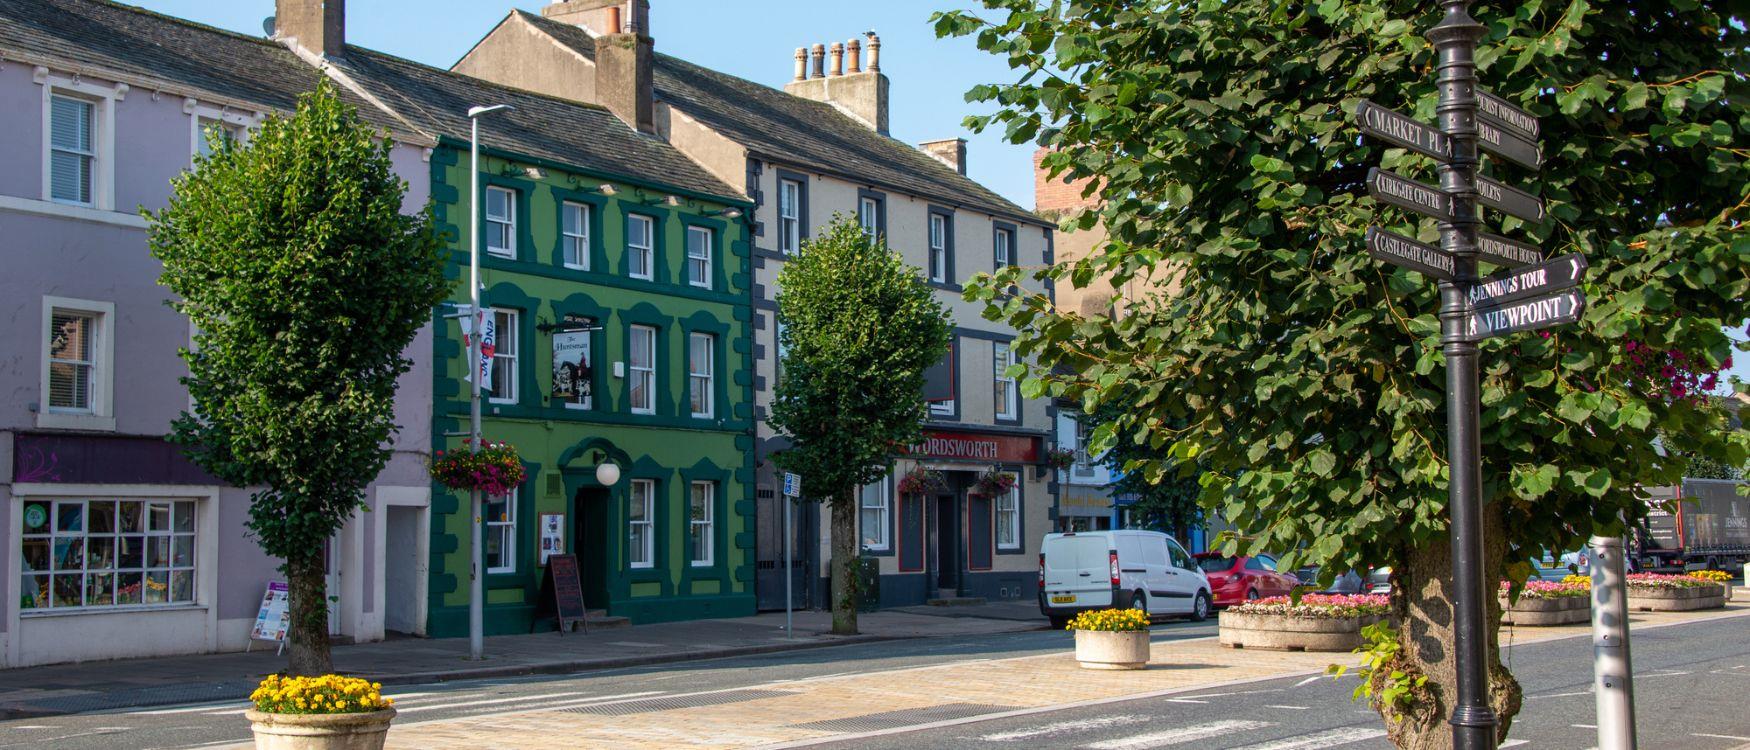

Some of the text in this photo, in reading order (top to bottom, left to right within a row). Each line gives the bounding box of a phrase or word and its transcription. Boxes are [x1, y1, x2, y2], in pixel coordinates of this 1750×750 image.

[1374, 109, 1442, 153] MARKET PL
[1499, 104, 1534, 133] INFORMATION
[1381, 176, 1440, 210] KIRKGATE CENTRE
[1380, 235, 1450, 272] CASTLEGATE GALLERY
[1518, 247, 1538, 265] HOUSE
[1475, 269, 1546, 301] JENNINGS TOUR
[1485, 297, 1561, 332] VIEWPOINT
